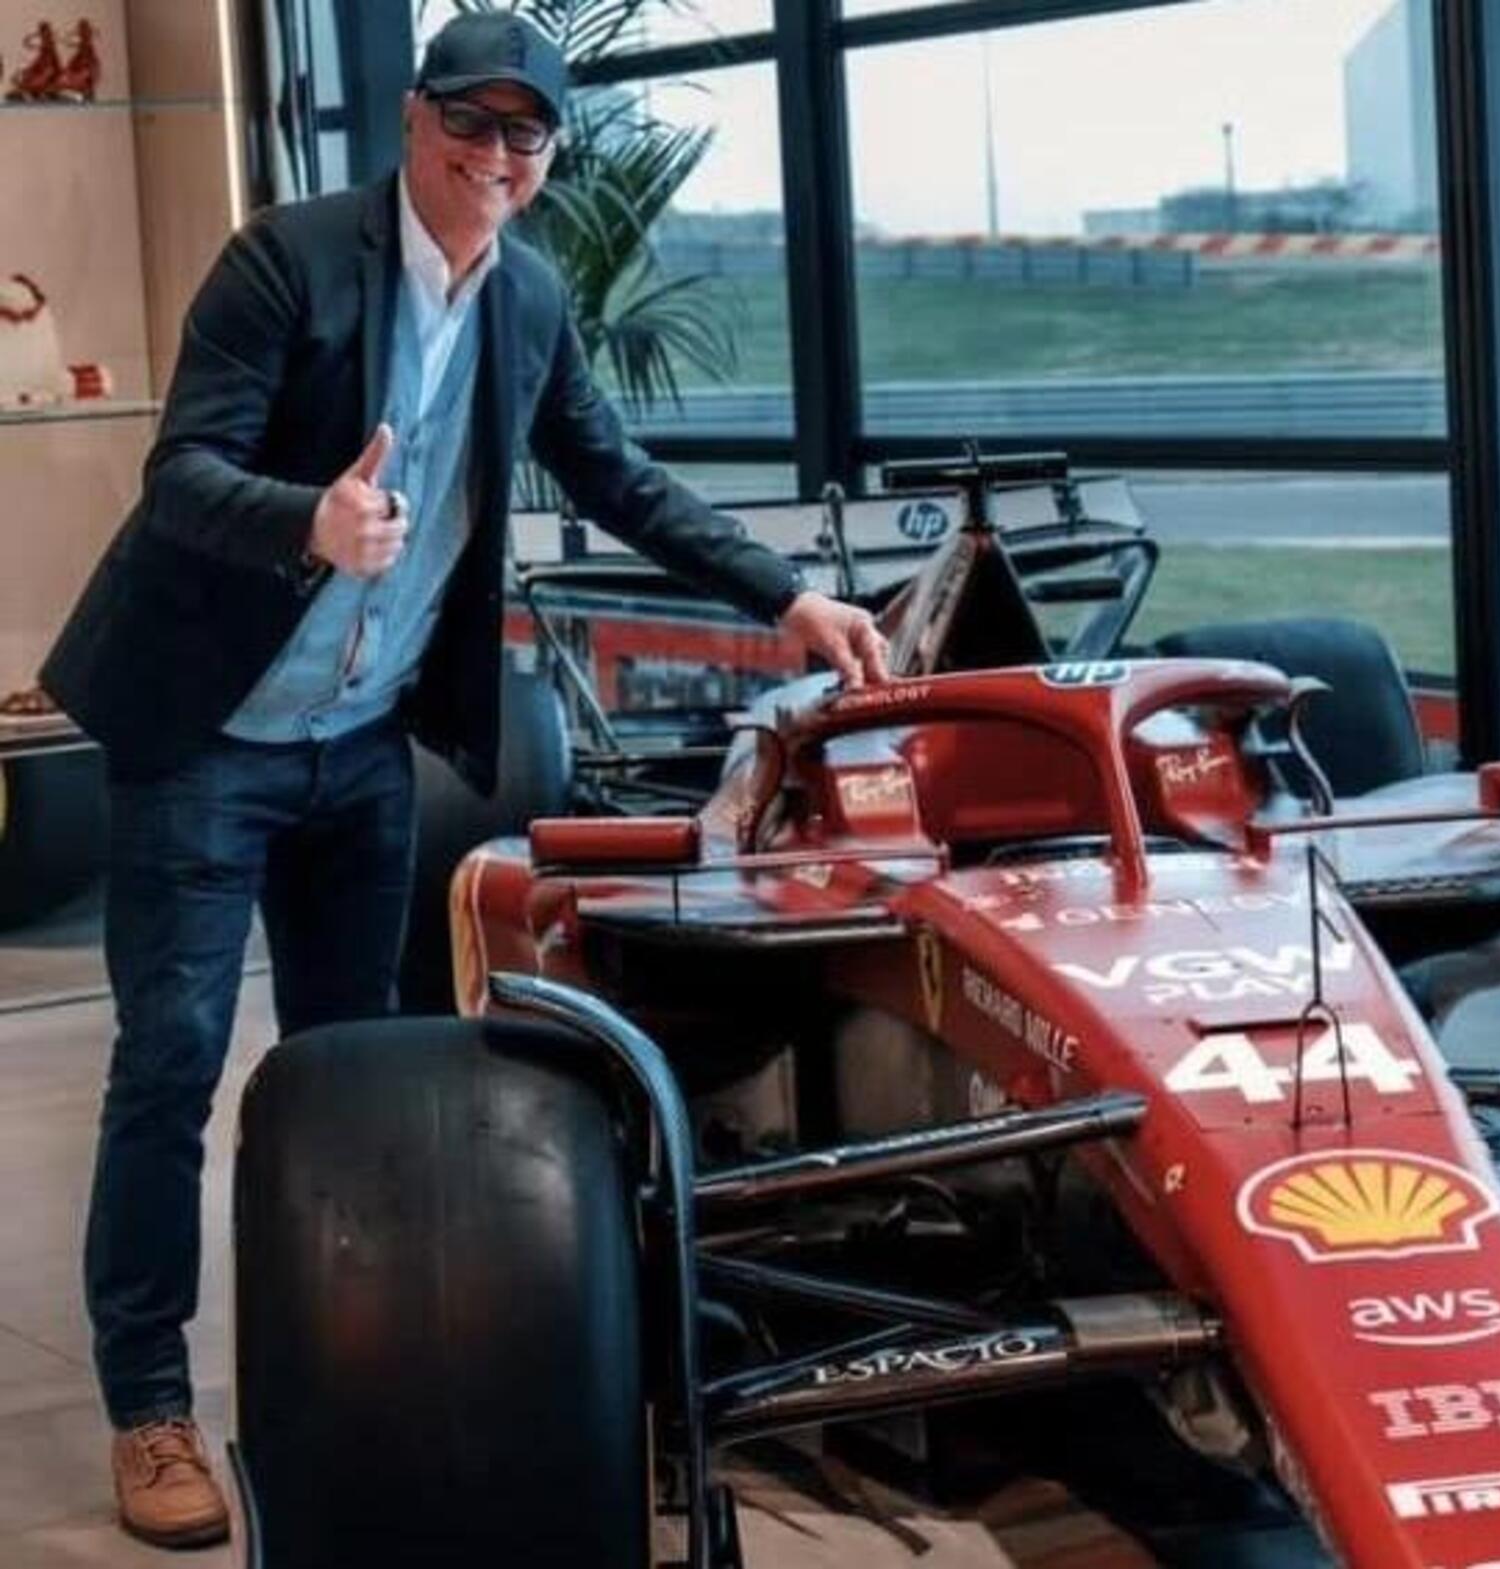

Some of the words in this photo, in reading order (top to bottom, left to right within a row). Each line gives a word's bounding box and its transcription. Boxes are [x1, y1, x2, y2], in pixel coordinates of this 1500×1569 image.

[905, 500, 942, 541] hp
[1051, 942, 1355, 990] VGW
[1163, 1021, 1422, 1103] 44
